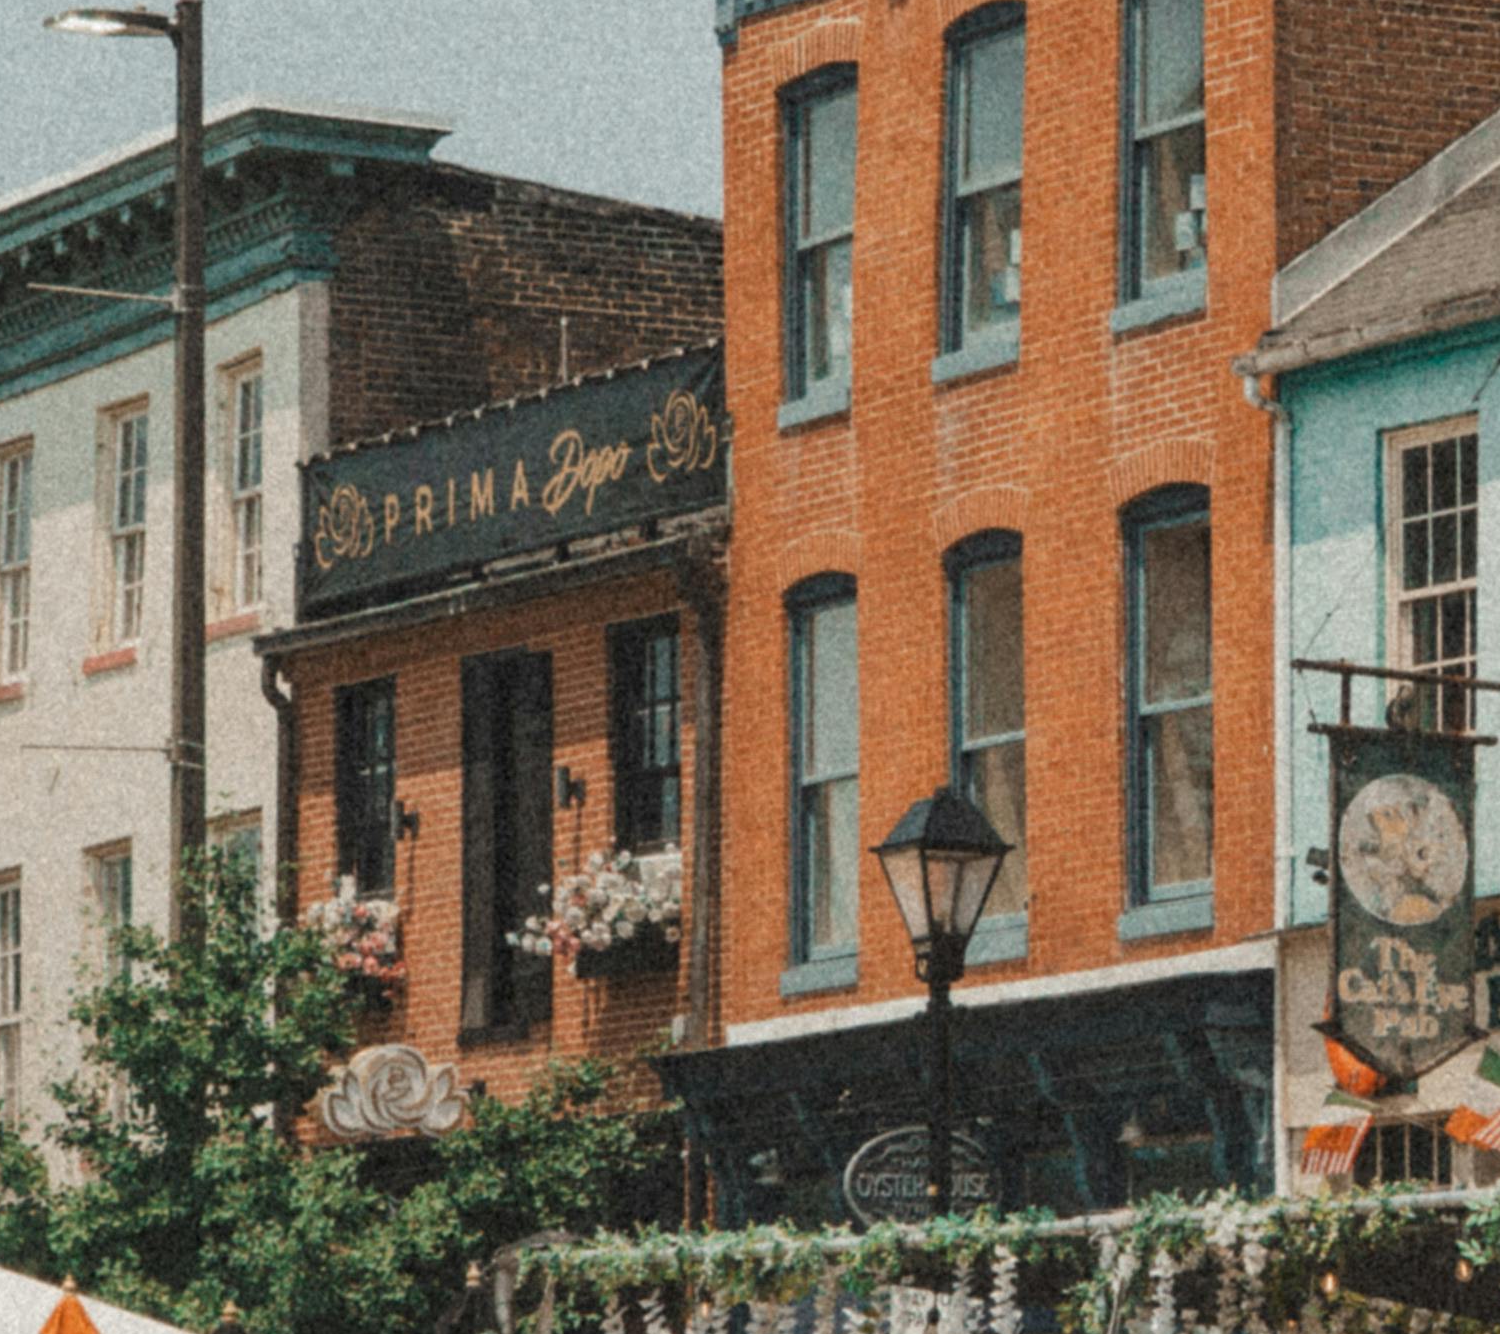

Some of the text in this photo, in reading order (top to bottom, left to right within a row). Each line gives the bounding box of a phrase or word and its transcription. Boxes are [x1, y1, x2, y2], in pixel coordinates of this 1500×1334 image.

[384, 428, 633, 545] PRIMA Dopo
[855, 1172, 927, 1199] OYSTER
